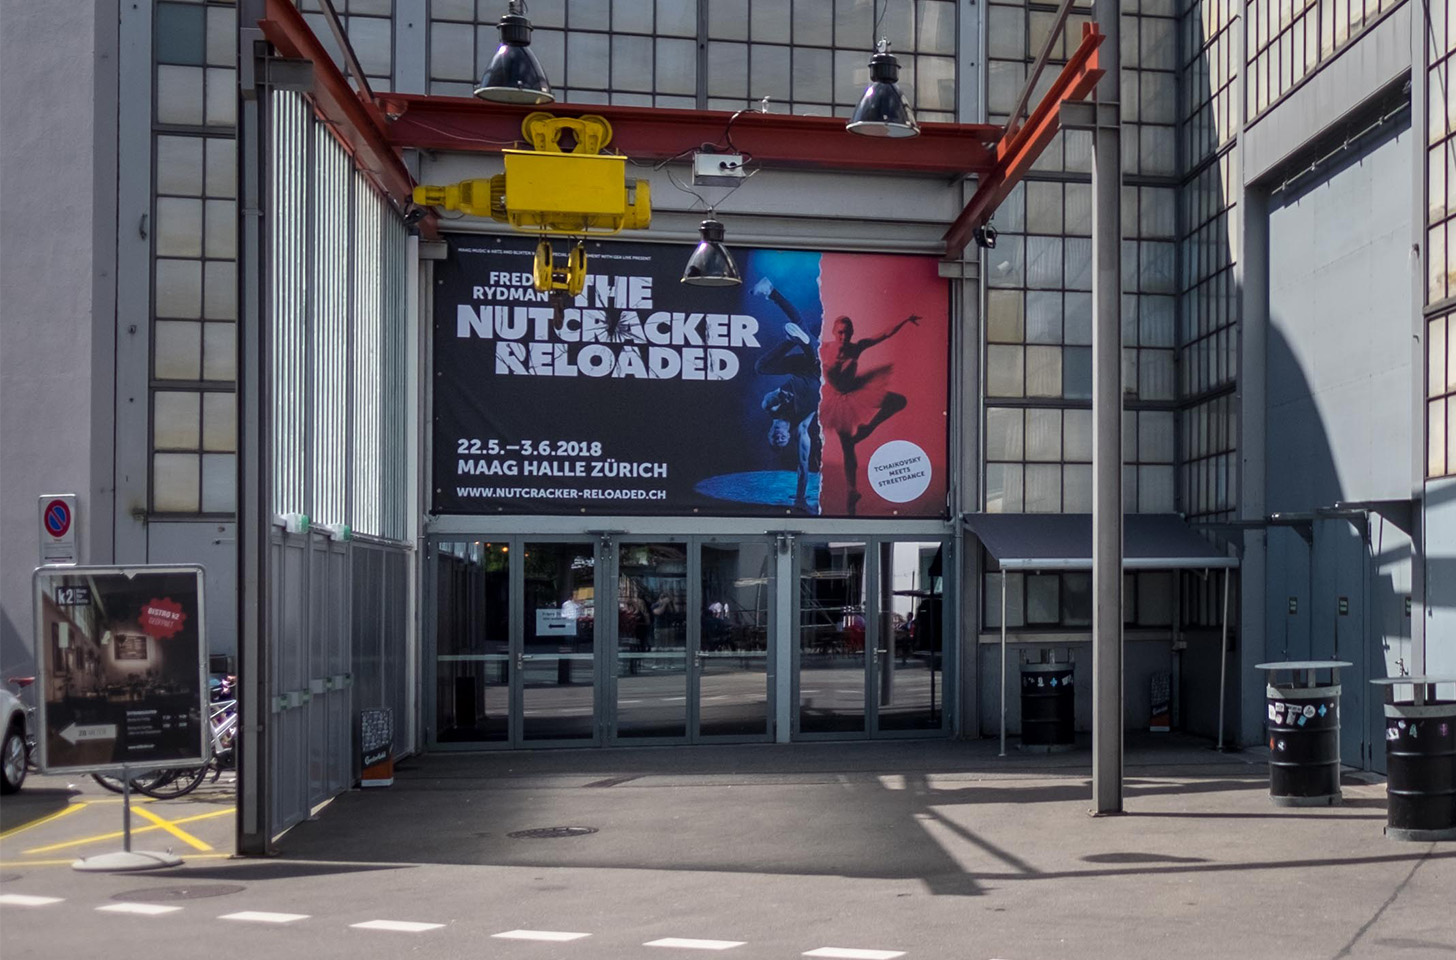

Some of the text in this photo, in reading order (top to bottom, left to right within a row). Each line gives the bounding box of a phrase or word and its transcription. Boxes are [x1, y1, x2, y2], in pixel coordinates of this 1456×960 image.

[489, 271, 535, 286] FRED
[574, 274, 653, 309] THE
[456, 304, 761, 348] NUTCRACKER
[494, 341, 740, 380] RELOADED
[457, 458, 668, 478] MAAG HALLE ZÜRICH
[874, 456, 921, 472] TCHAIKOVSKY
[889, 467, 911, 477] MEETS
[878, 471, 925, 487] STREETDANCE
[456, 487, 667, 500] WWW.NUTCRACKER-RELOADED.CH
[58, 588, 74, 605] k2
[147, 607, 171, 619] BISTRO
